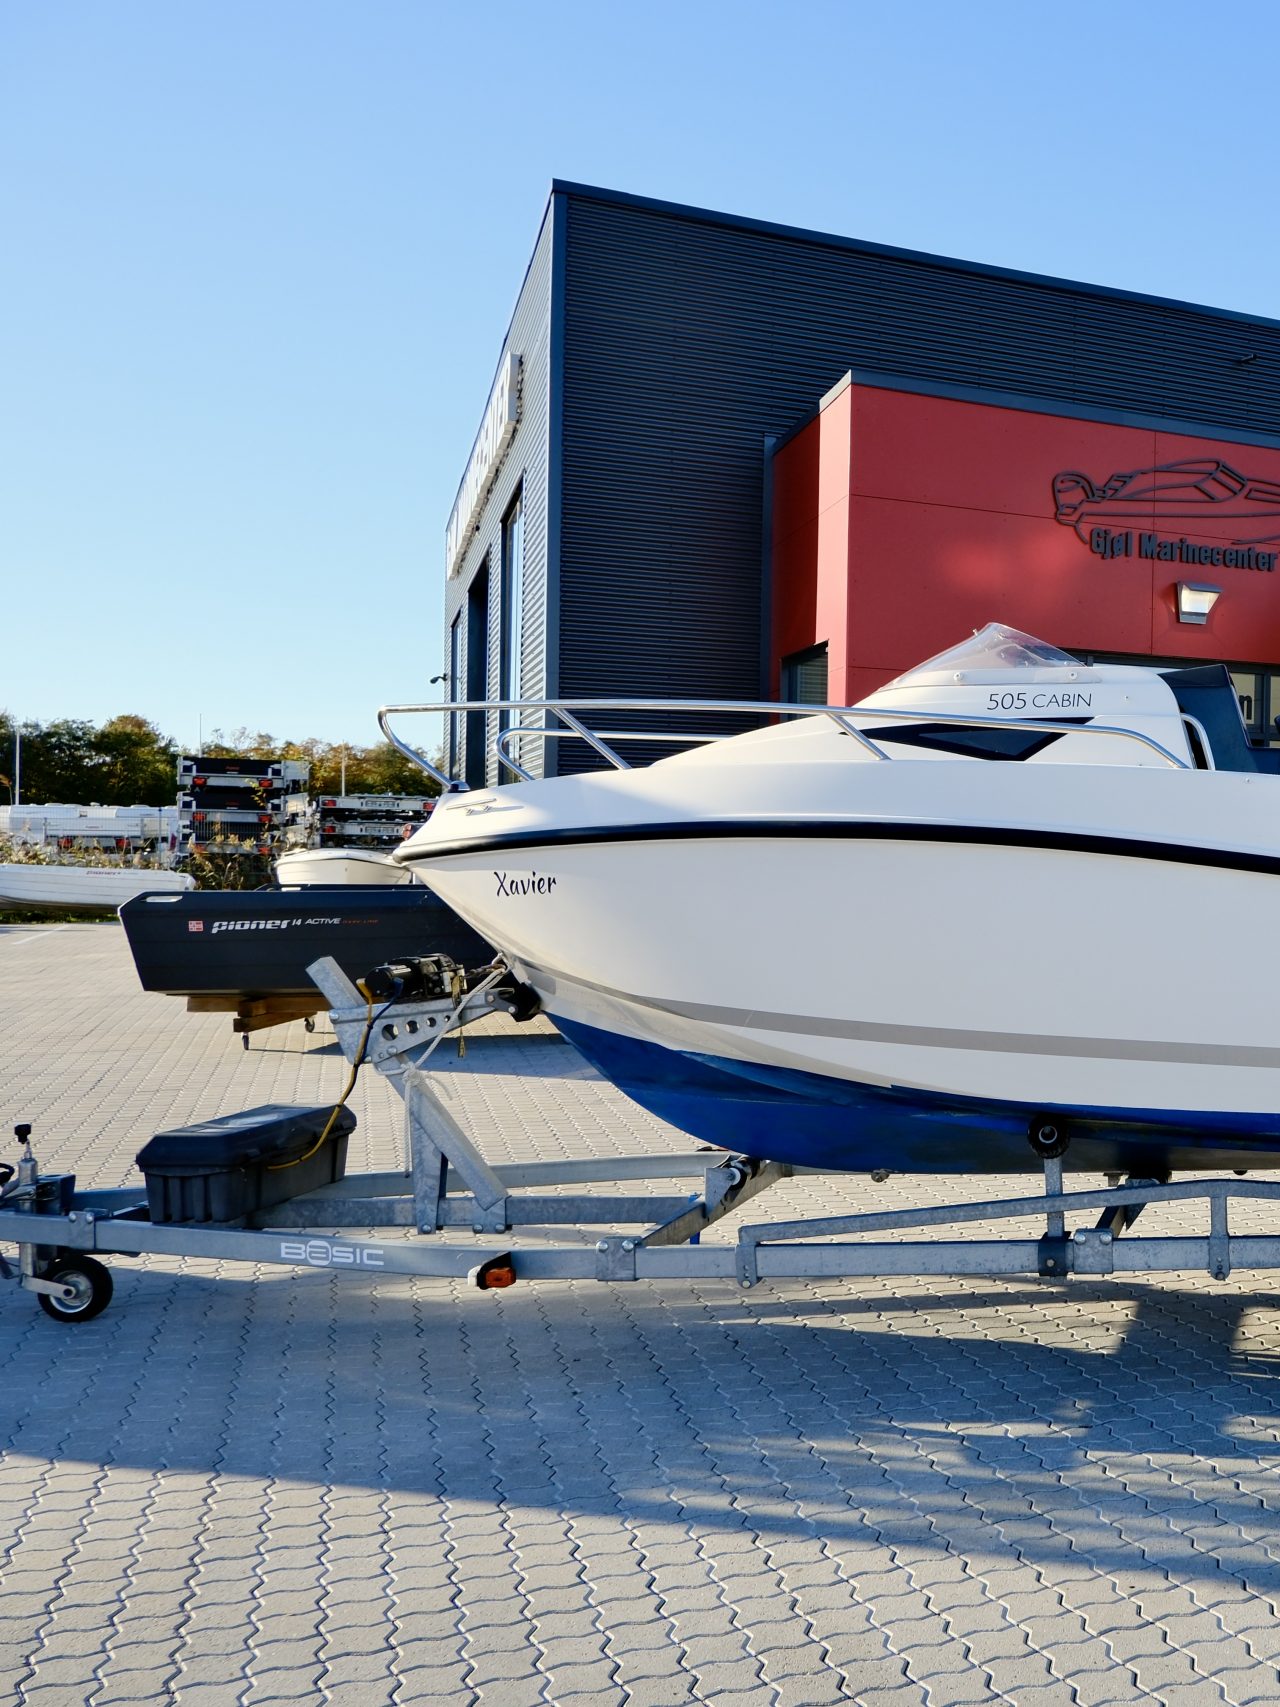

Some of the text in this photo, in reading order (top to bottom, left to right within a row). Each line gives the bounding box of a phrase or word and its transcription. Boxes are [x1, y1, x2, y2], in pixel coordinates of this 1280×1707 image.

[1090, 527, 1279, 572] Gjøl Marinecenter
[986, 692, 1092, 711] 505 CABIN
[493, 870, 557, 897] Xavier
[211, 920, 291, 934] pioner
[292, 918, 302, 926] 14
[305, 917, 341, 925] ACTIVE
